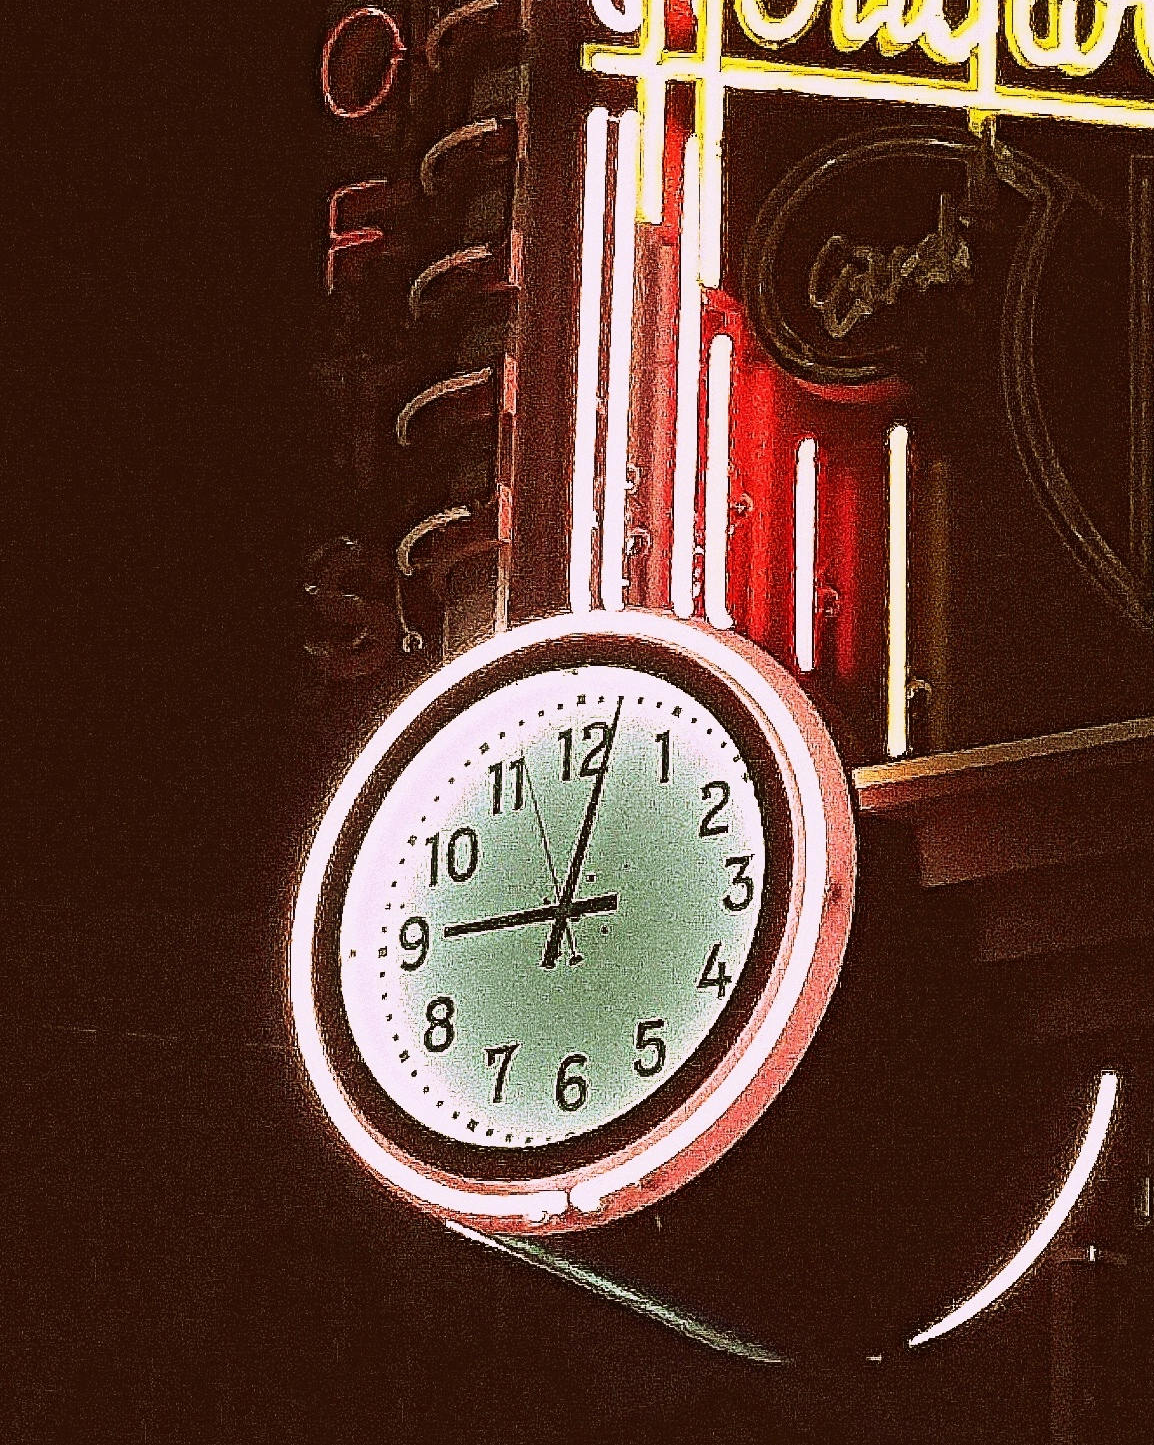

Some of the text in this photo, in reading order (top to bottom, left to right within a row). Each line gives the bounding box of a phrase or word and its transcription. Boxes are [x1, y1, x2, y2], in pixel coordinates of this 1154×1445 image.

[558, 721, 609, 782] 12
[655, 730, 674, 784] 1
[488, 756, 527, 815] 11
[699, 780, 730, 838] 2
[425, 826, 480, 887] 10
[722, 855, 755, 913] 3
[398, 915, 430, 972] 9
[696, 942, 734, 1000] 4
[423, 996, 456, 1053] 8
[633, 1018, 666, 1078] 5
[485, 1042, 519, 1105] 7
[554, 1054, 590, 1113] 6
